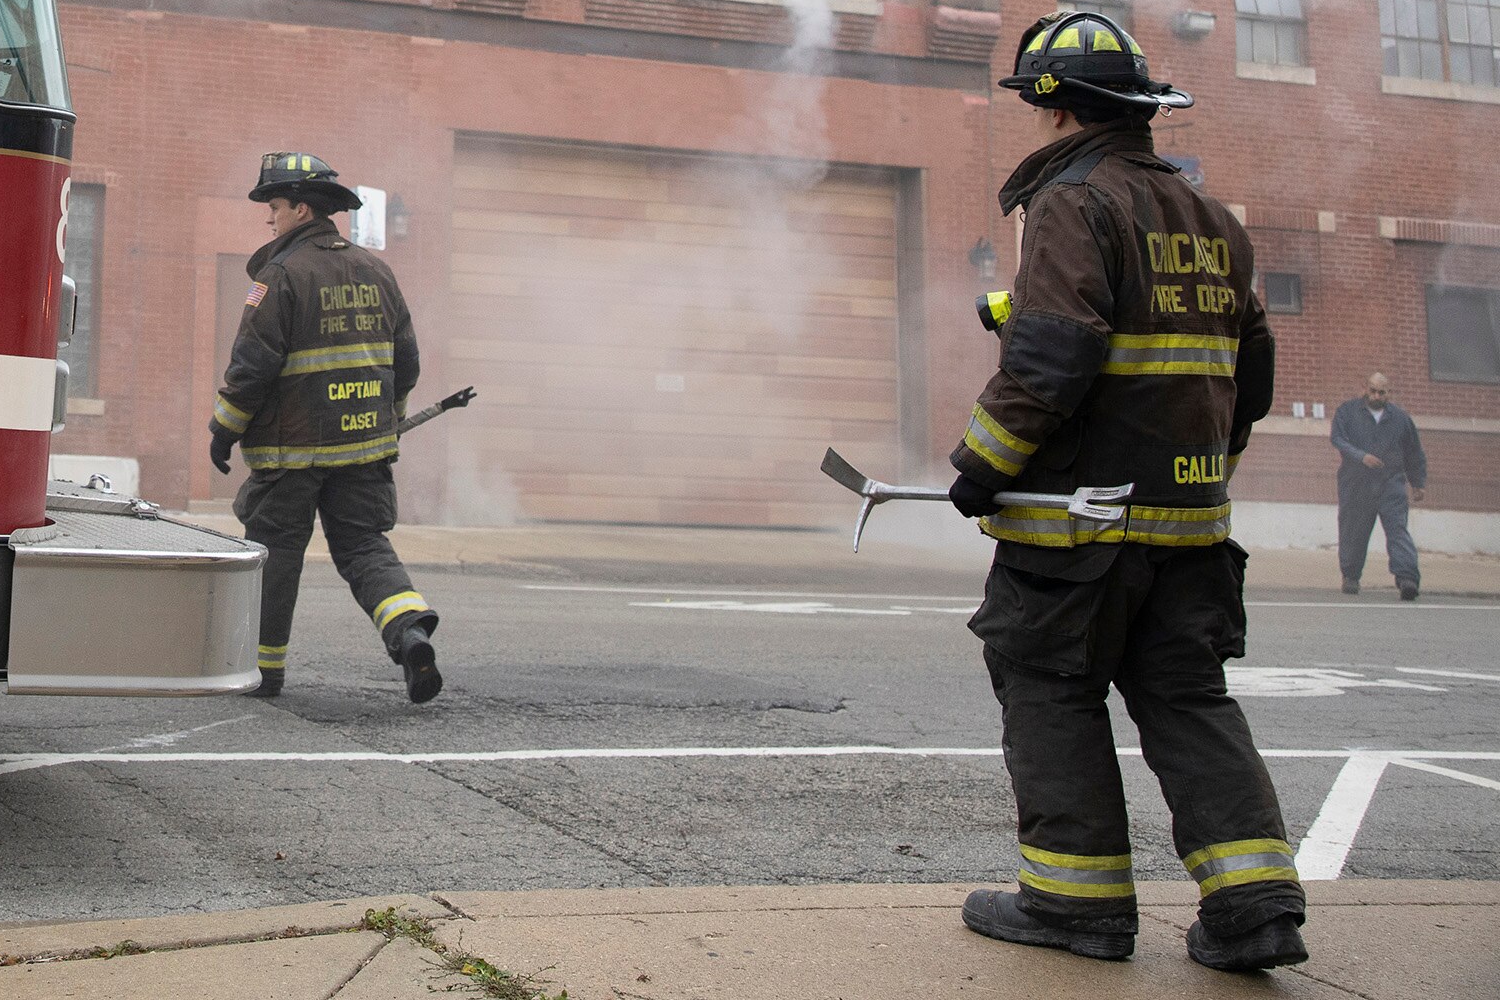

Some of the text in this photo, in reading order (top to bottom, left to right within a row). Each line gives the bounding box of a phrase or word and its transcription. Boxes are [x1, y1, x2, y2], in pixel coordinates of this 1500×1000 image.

[1146, 231, 1231, 277] CHICAGO
[320, 284, 381, 311] CHICAGO
[1195, 284, 1237, 316] DEPT
[320, 314, 383, 335] FIRE DEPT
[328, 379, 382, 401] CAPTAIN
[340, 411, 378, 431] CASEY
